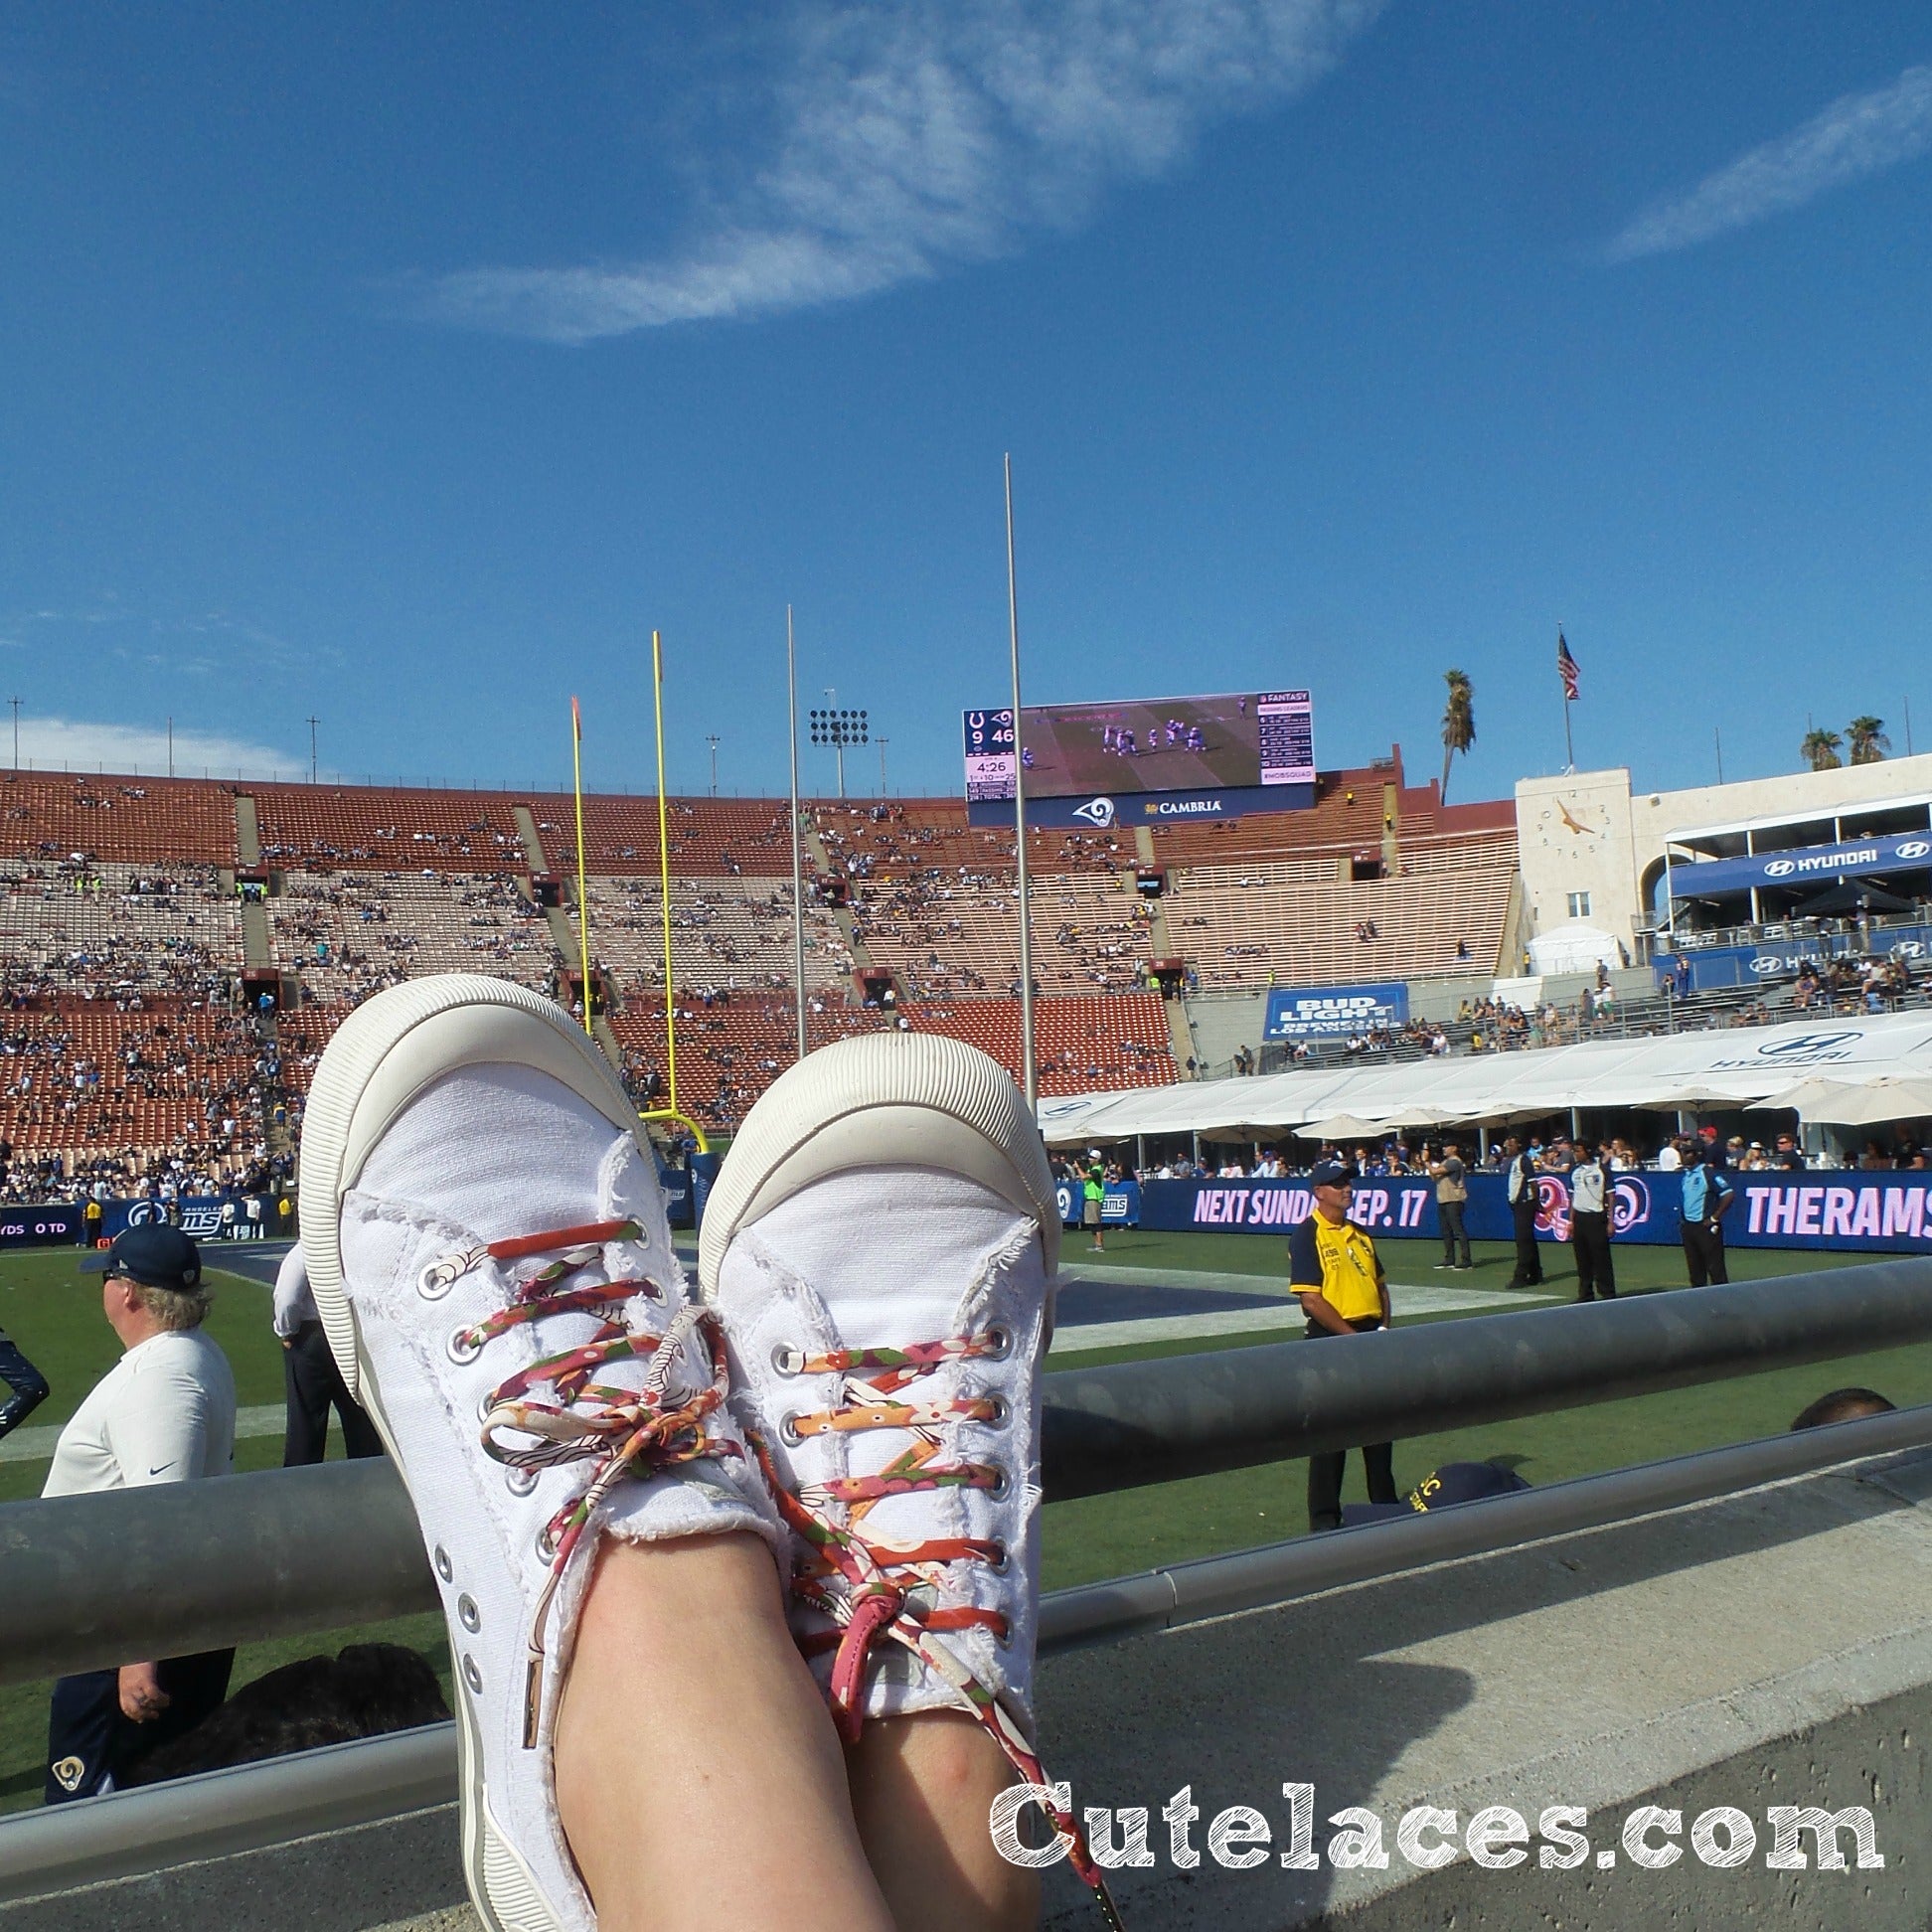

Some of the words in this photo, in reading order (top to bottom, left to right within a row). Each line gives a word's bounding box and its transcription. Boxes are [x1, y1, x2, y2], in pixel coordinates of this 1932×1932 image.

[1268, 692, 1308, 703] FANTASY
[972, 730, 983, 744] 9
[991, 728, 1014, 743] 46
[977, 761, 1007, 773] 4:26
[1159, 800, 1222, 814] CAMBRIA
[1797, 849, 1878, 872] HYUNDAI
[1296, 997, 1376, 1011] BUD
[1280, 1006, 1393, 1022] LIGHT
[1709, 1050, 1853, 1068] HYUNDAI
[1194, 1190, 1250, 1223] NEXT
[1399, 1191, 1428, 1227] 17
[48, 1222, 67, 1233] TD
